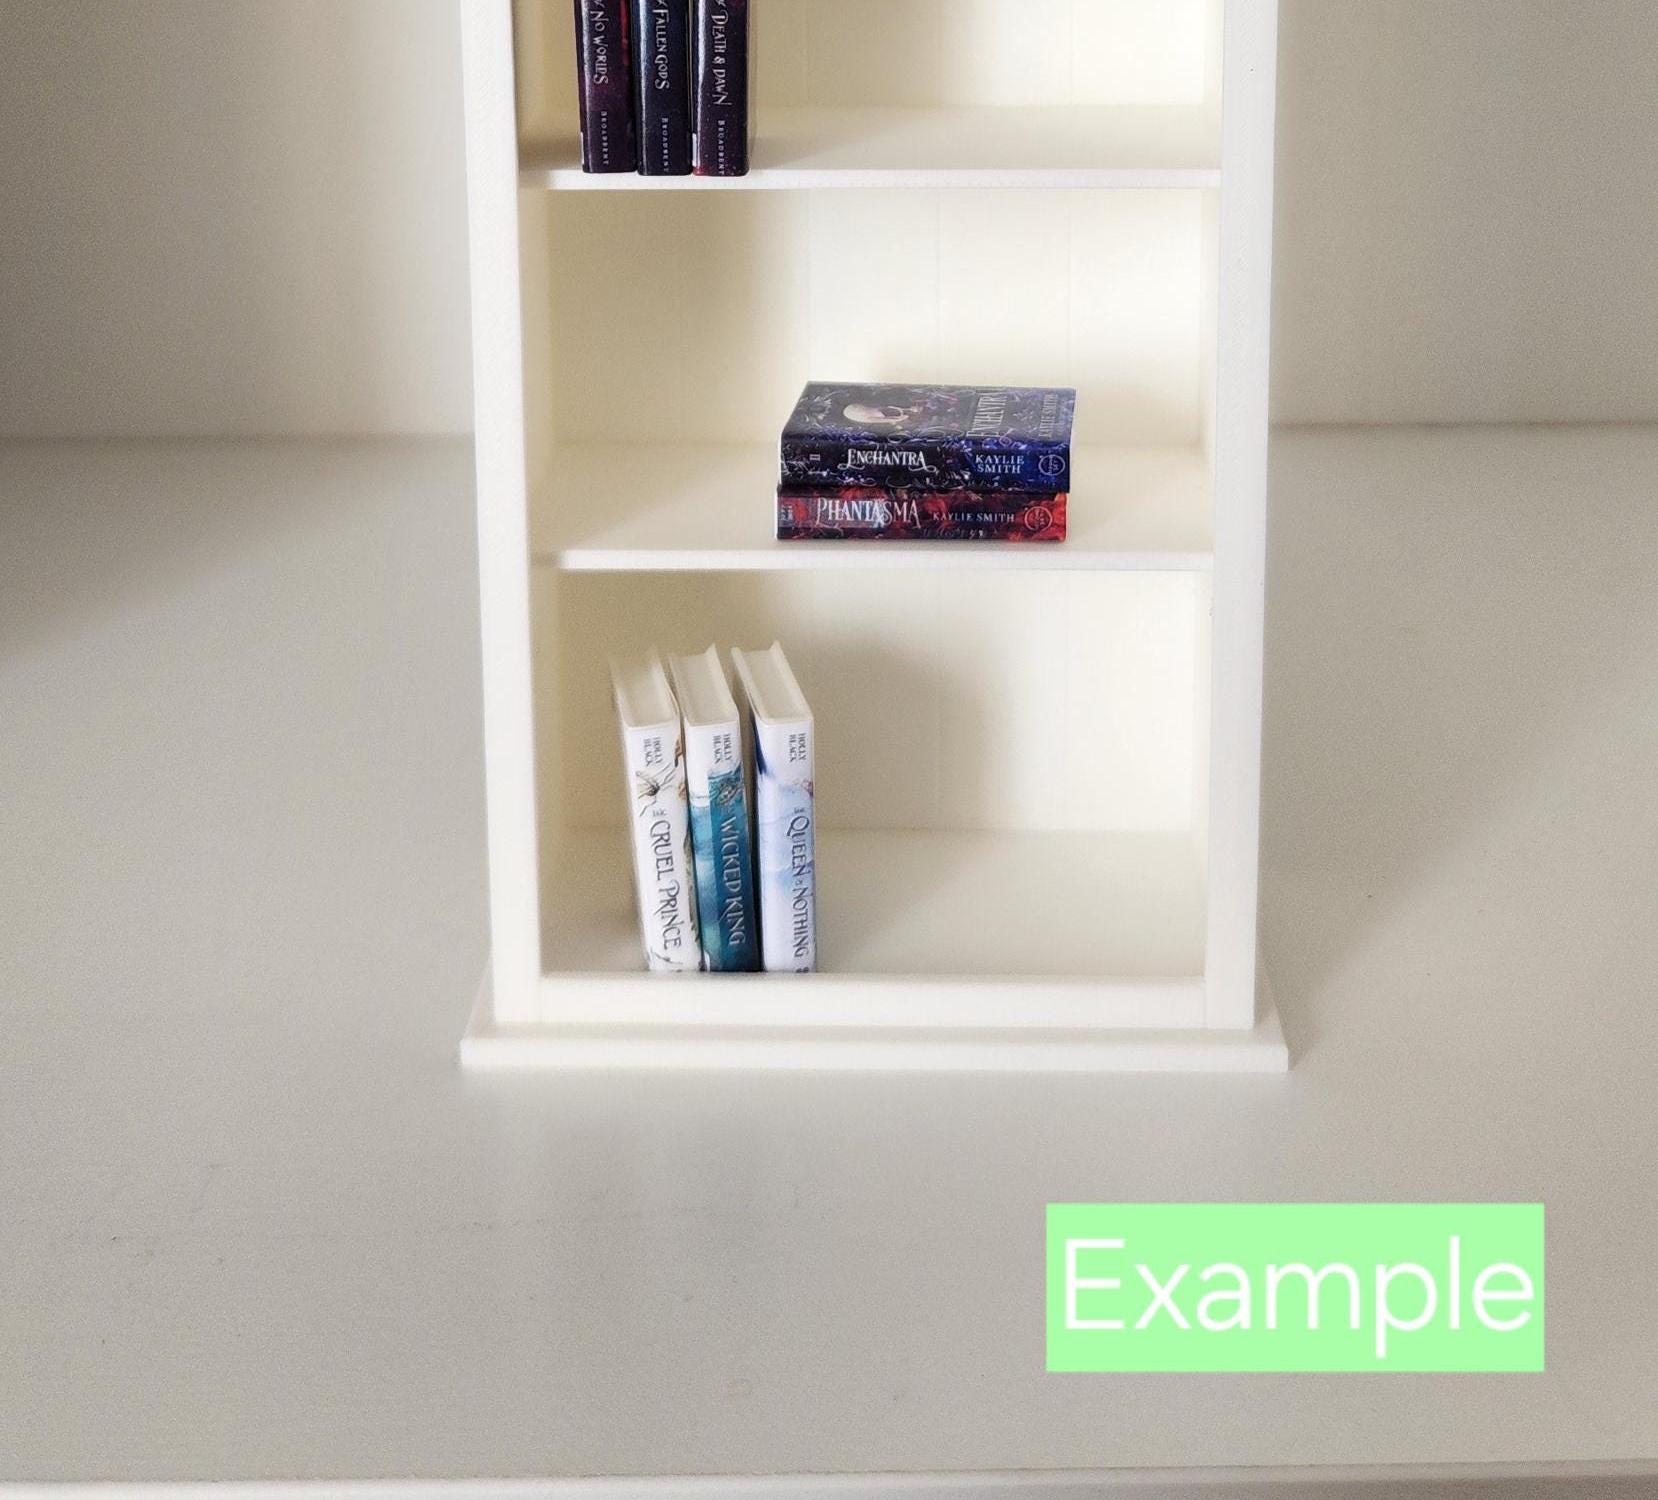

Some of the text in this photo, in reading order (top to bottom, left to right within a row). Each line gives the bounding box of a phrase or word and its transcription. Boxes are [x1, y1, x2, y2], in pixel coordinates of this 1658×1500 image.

[590, 11, 609, 32] NO
[652, 9, 670, 52] FALLEN
[711, 10, 729, 53] DEATH
[594, 37, 609, 84] WORLDS
[654, 55, 670, 90] GODS
[712, 69, 732, 105] DAWN
[600, 111, 609, 165] BROADBENT
[717, 120, 726, 175] BROADBENT
[837, 448, 937, 472] ENCHANTRA
[975, 454, 1025, 465] KAYLIE
[977, 464, 1021, 474] SMITH
[815, 497, 922, 530] PHANTASMA
[932, 511, 973, 521] KAYLIE
[976, 512, 1015, 522] SMITH
[719, 817, 743, 893] WICKED
[787, 816, 810, 878] QUEEN
[650, 821, 684, 950] CRUEL PRINCE
[717, 897, 745, 947] KING
[793, 888, 812, 958] NOTHING
